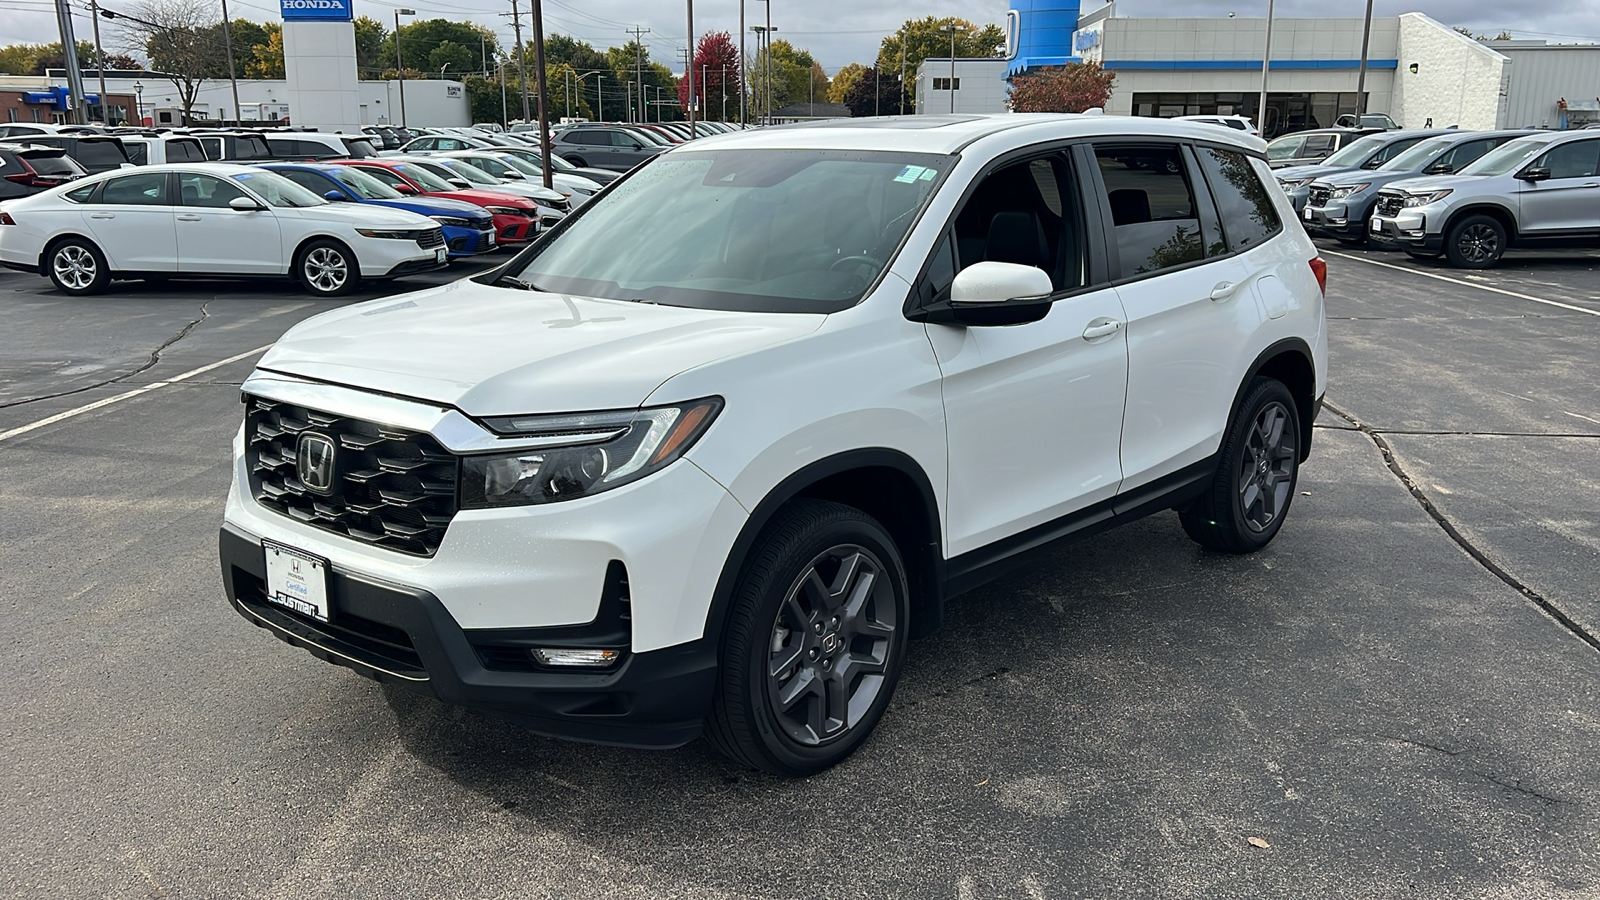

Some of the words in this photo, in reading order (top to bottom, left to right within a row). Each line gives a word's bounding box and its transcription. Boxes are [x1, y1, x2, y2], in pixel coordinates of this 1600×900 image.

[282, 0, 345, 9] HONDA
[287, 572, 304, 581] HONDA
[286, 581, 307, 594] Certified
